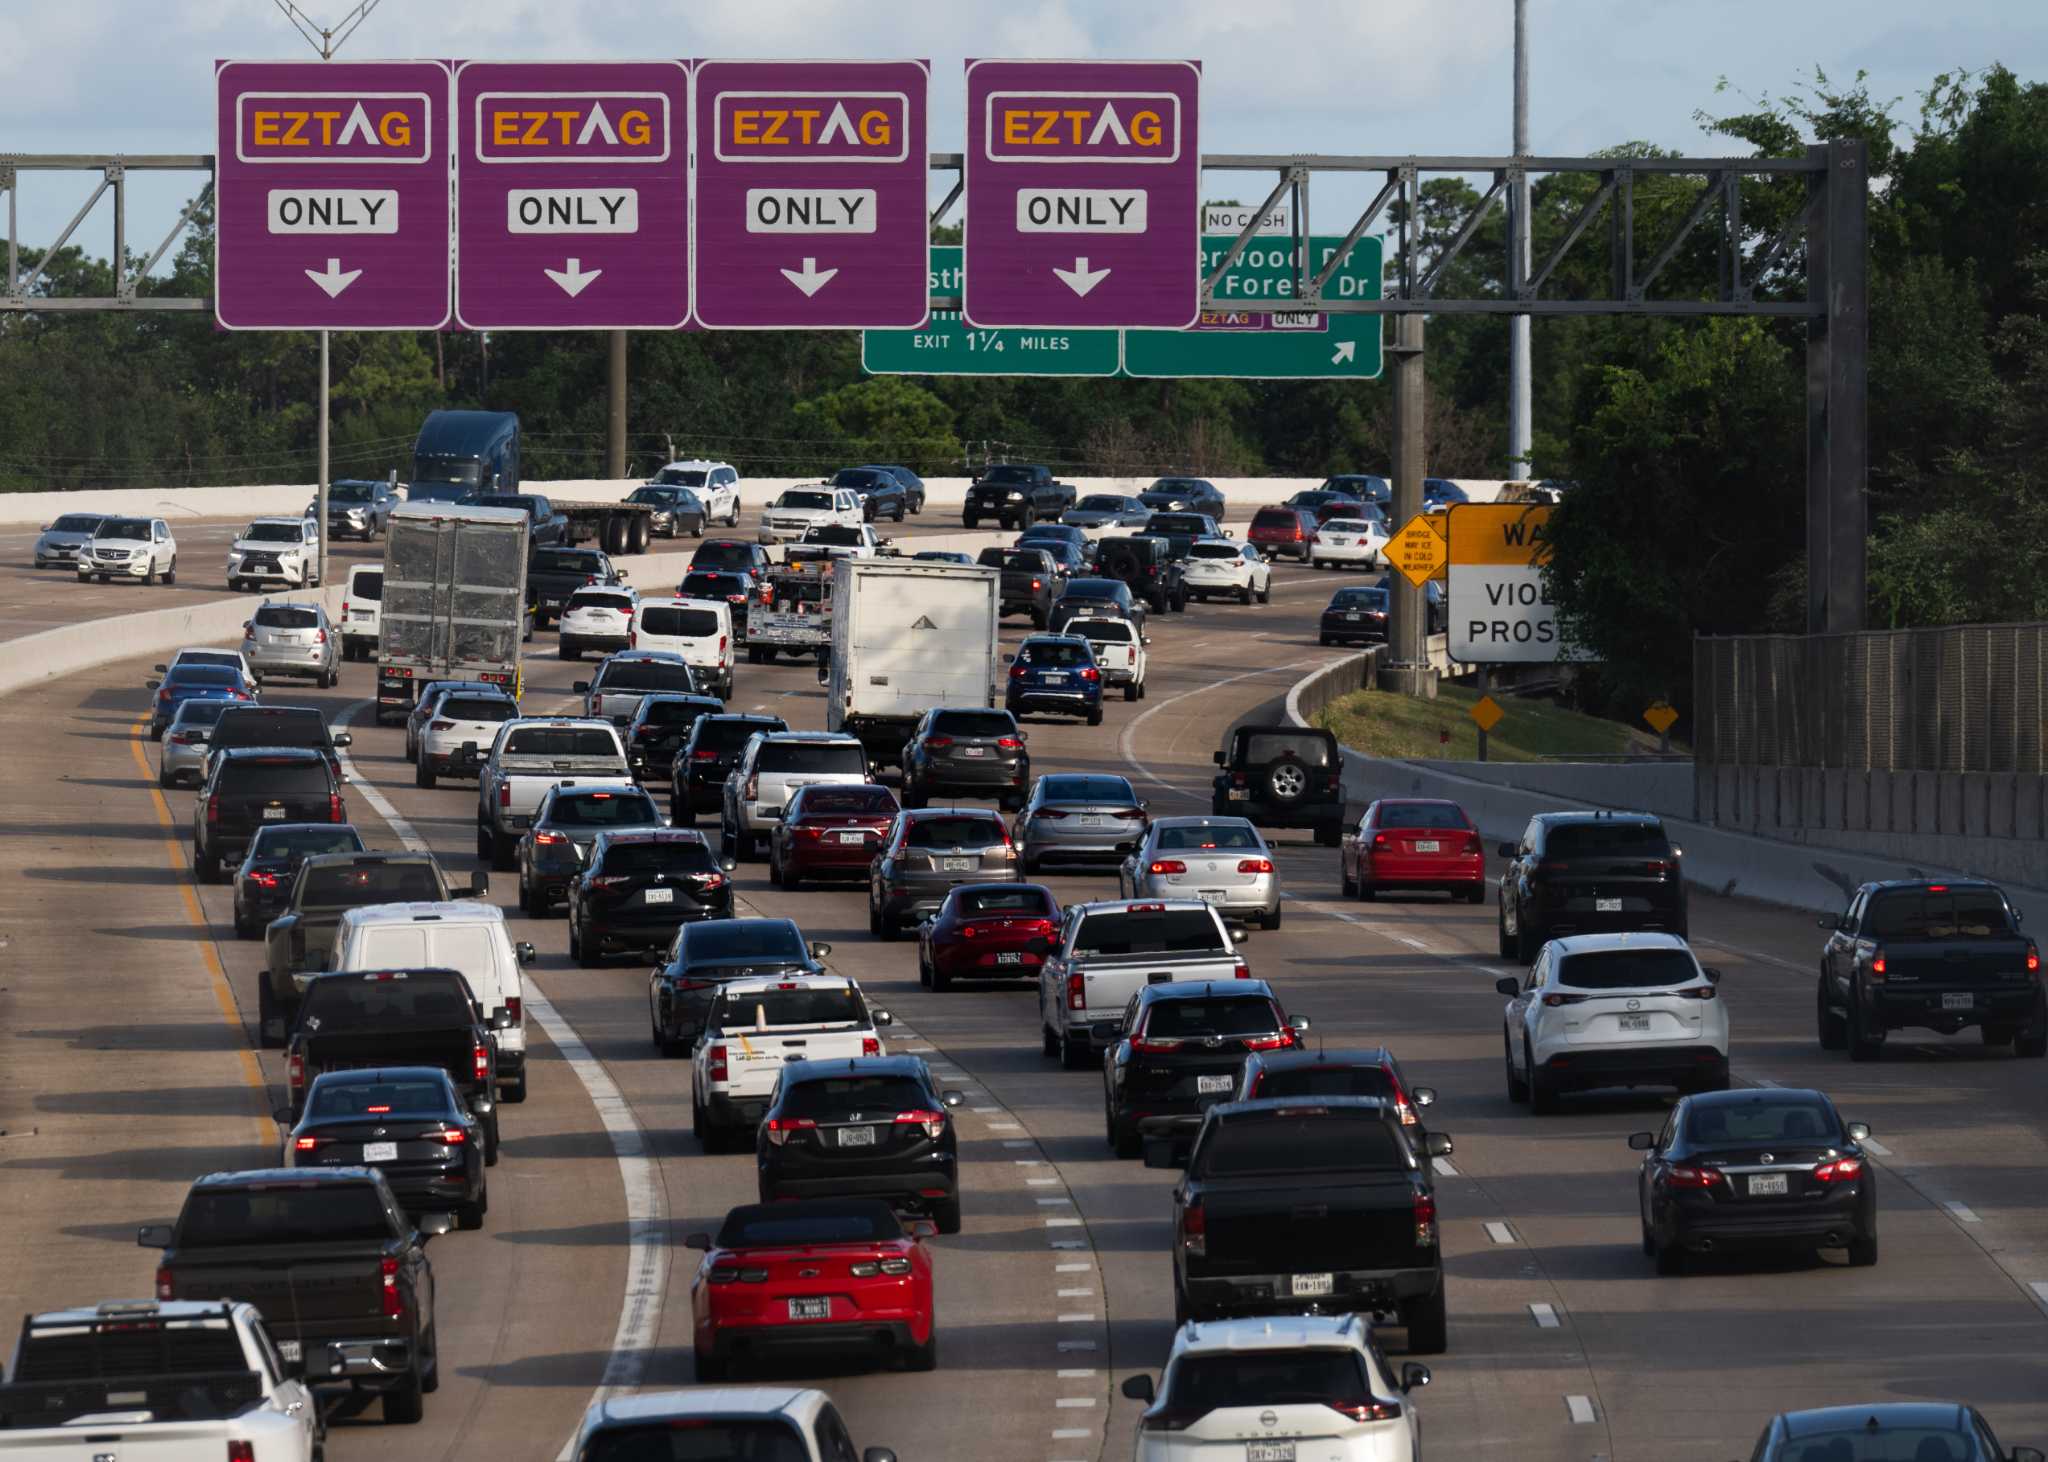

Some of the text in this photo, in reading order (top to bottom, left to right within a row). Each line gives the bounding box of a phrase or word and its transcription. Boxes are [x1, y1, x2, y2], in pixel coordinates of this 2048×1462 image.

[254, 100, 411, 146] EZTAG
[493, 100, 651, 146] EZTAG
[733, 101, 890, 145] EZTAG
[1004, 101, 1162, 145] EZTAG
[279, 197, 386, 225] ONLY
[519, 196, 626, 225] ONLY
[757, 196, 865, 225] ONLY
[1028, 196, 1136, 226] ONLY
[1208, 214, 1284, 227] NO CSH
[1226, 275, 1369, 296] Fore Dr
[1275, 312, 1315, 325] ONLY
[913, 334, 950, 348] EXIT
[1020, 336, 1070, 350] MILES
[1404, 541, 1432, 550] MAY ICE
[1406, 530, 1432, 538] BRIDGE
[1403, 552, 1433, 561] IN COLD
[1403, 563, 1434, 571] WEATHER
